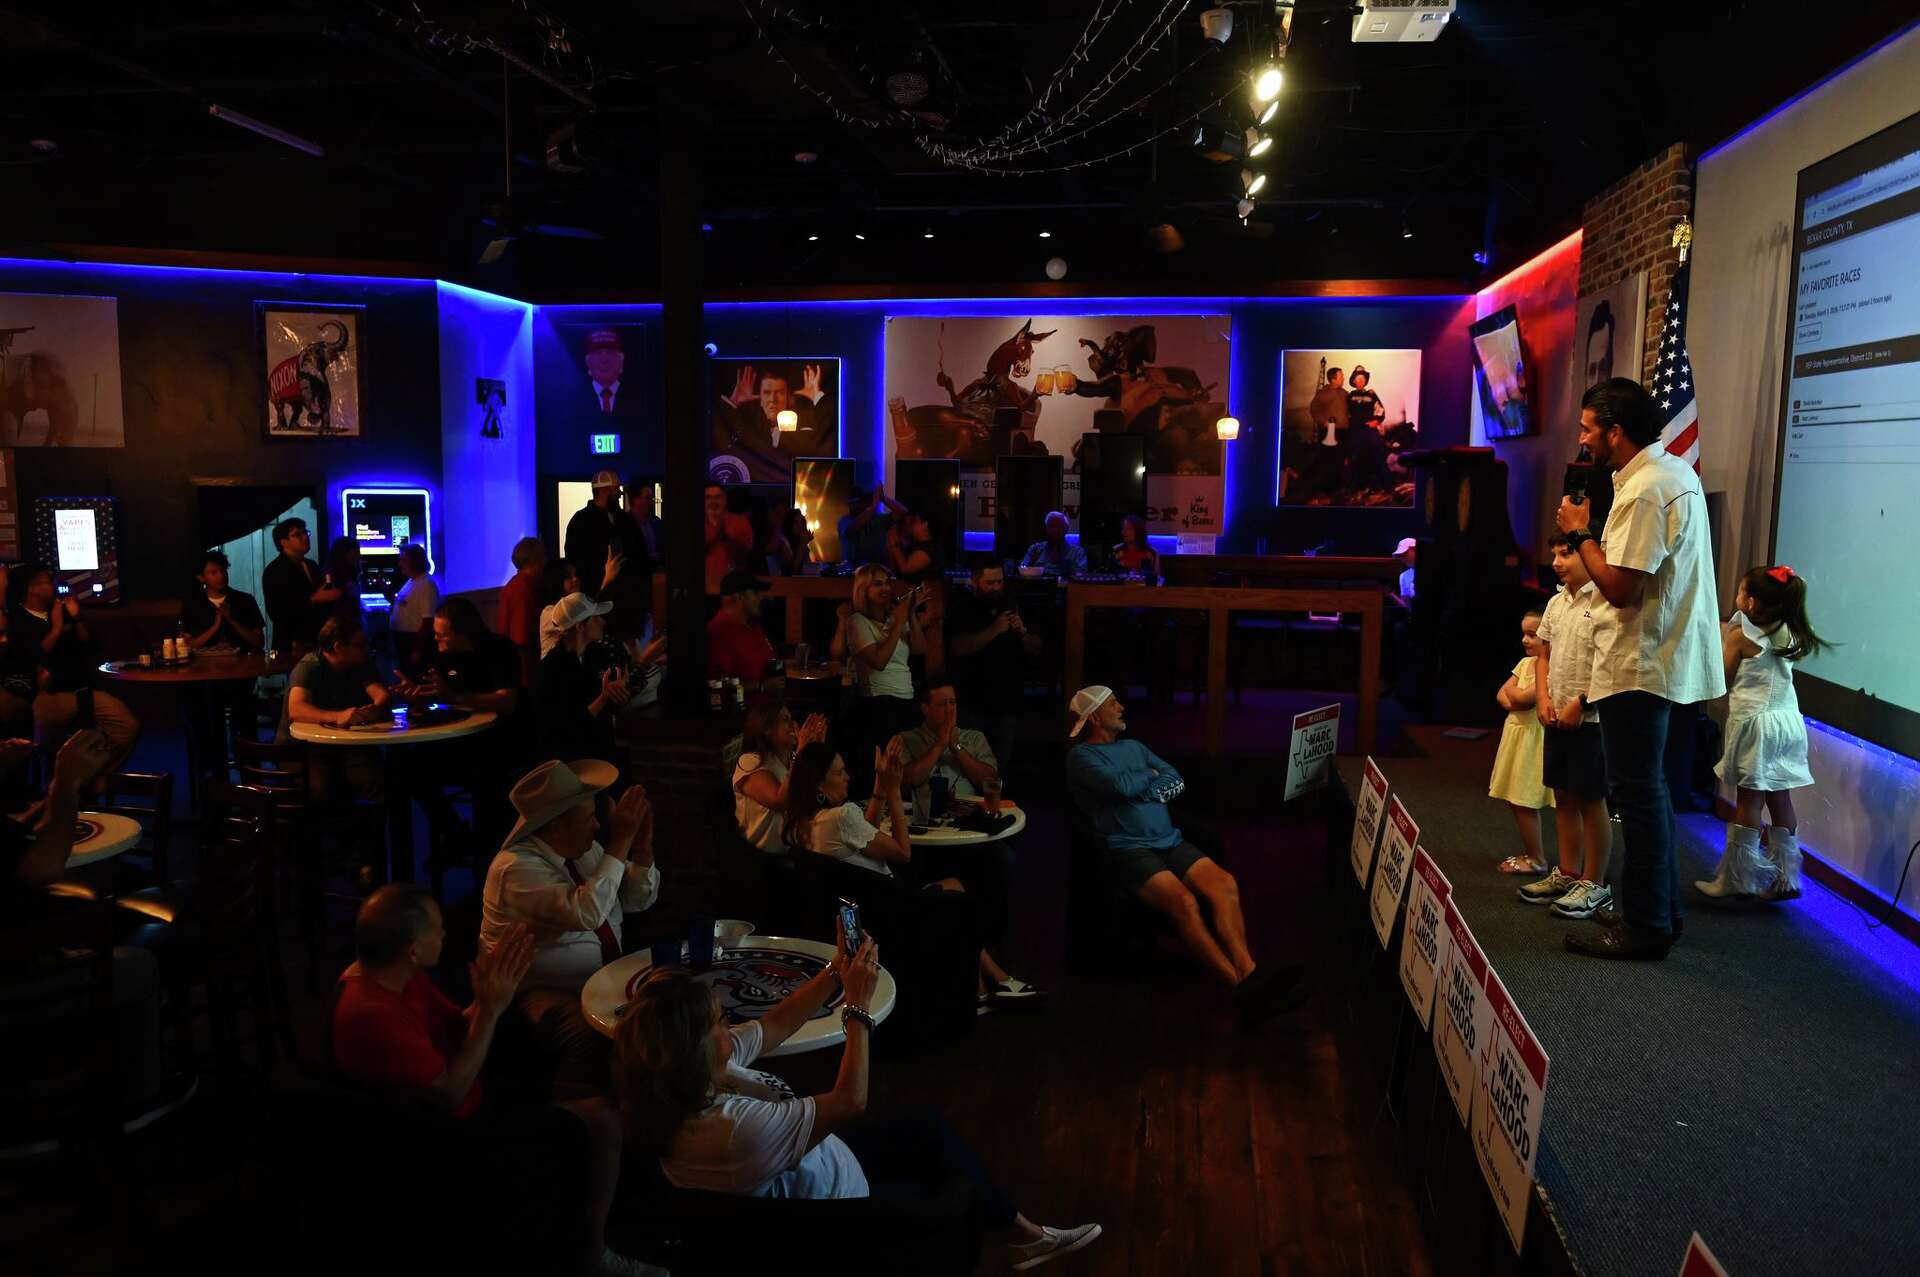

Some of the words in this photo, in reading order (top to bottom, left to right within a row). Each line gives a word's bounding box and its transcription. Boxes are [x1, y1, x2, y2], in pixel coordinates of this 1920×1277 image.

[1800, 282, 1809, 296] MY
[1810, 274, 1839, 294] FAVORITE
[1840, 267, 1861, 285] RACES
[270, 360, 298, 397] NIXON
[595, 434, 615, 452] EXIT
[1190, 503, 1208, 516] King
[1310, 729, 1331, 744] MARC
[1421, 900, 1439, 938] MARC
[1454, 963, 1475, 1019] MARC
[1448, 982, 1475, 1050] LAHOOD
[1502, 1002, 1525, 1049] RE-ELECT
[1499, 1052, 1529, 1122] MARC
[1490, 1070, 1530, 1161] LAHOOD
